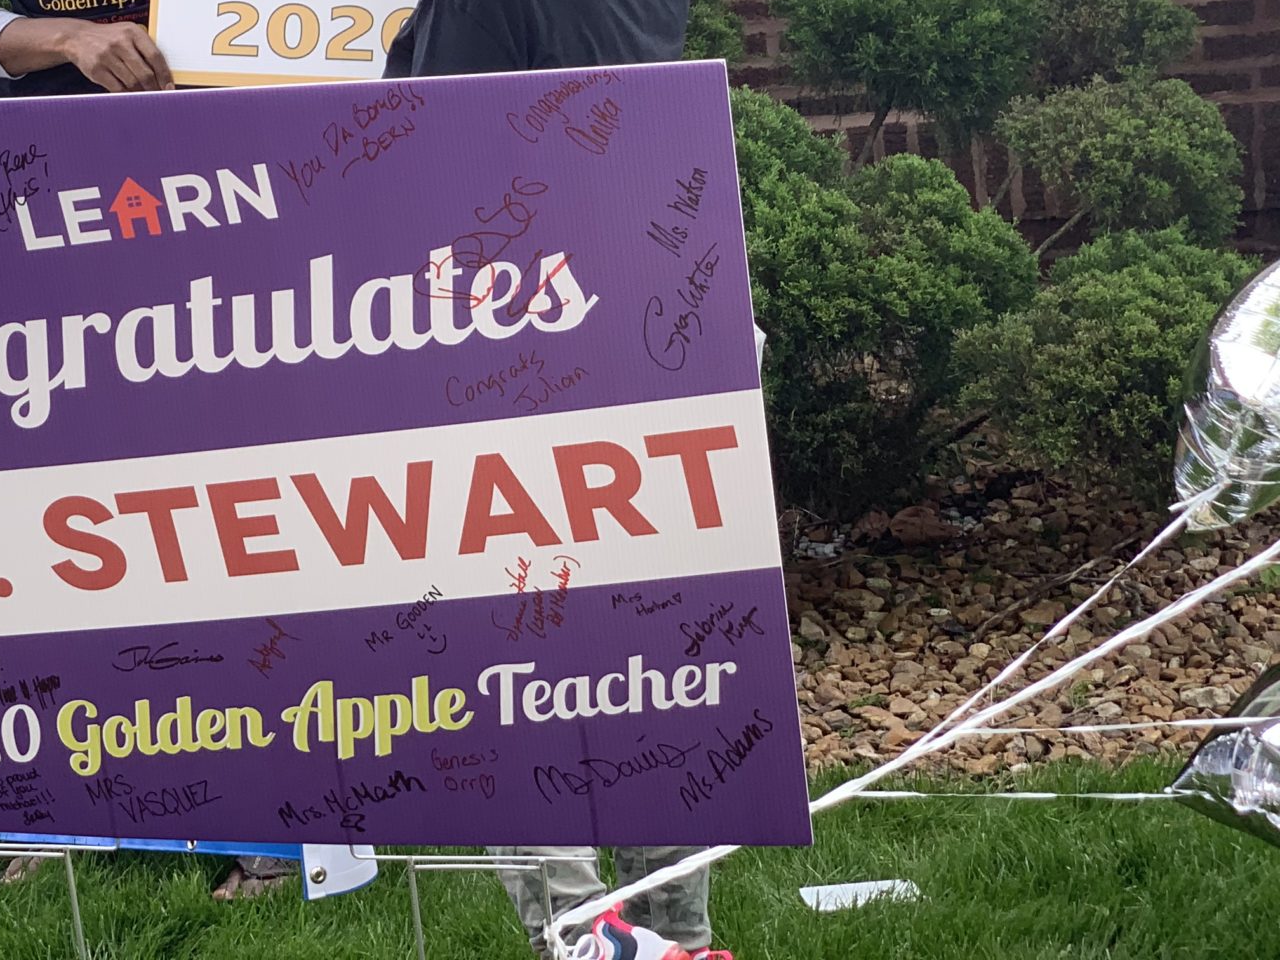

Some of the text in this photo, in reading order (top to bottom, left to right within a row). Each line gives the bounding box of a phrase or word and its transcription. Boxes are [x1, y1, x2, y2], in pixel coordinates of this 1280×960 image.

[14, 163, 280, 251] LEARN
[44, 425, 739, 590] STEWART
[56, 695, 276, 777] Golden
[281, 674, 475, 760] Apple
[477, 654, 738, 726] Teacher
[118, 779, 223, 823] VASQUEZ
